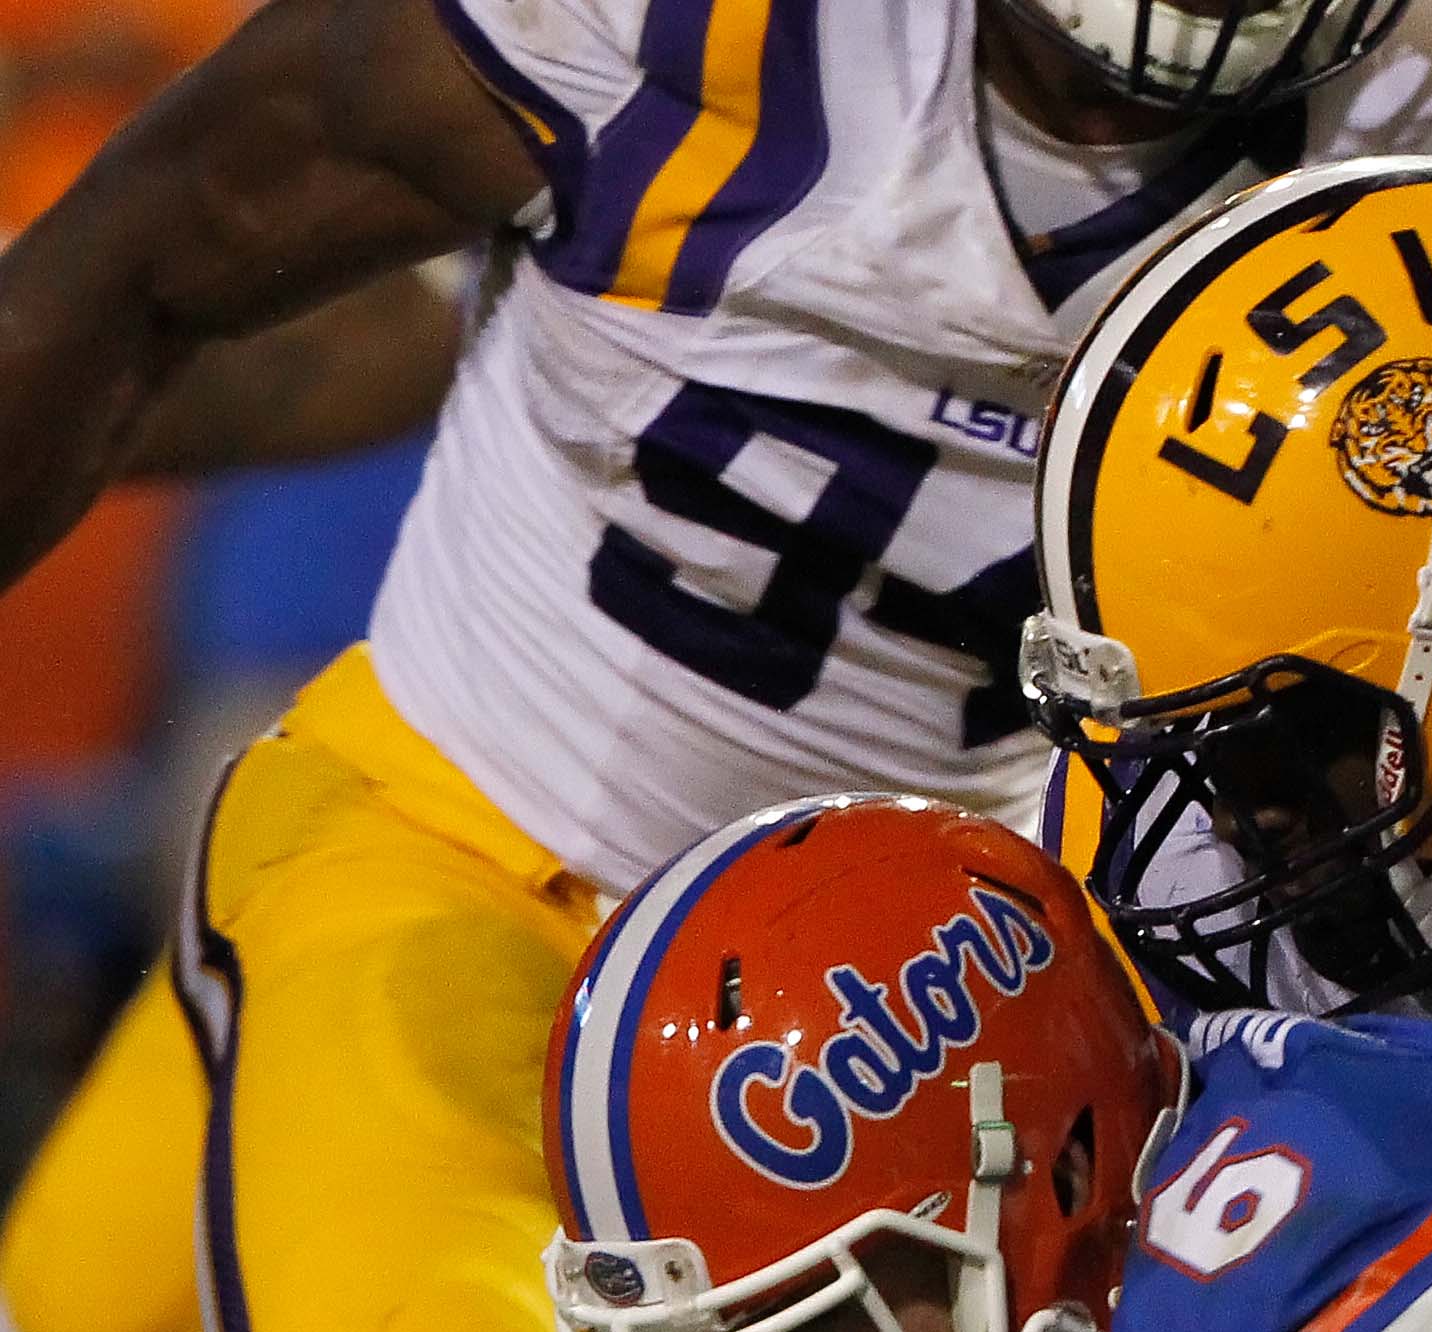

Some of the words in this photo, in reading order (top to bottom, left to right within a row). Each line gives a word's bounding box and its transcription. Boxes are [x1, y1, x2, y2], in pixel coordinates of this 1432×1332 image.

[931, 388, 1040, 459] LSU
[710, 888, 1053, 1190] Gators
[1138, 1115, 1315, 1284] 6
